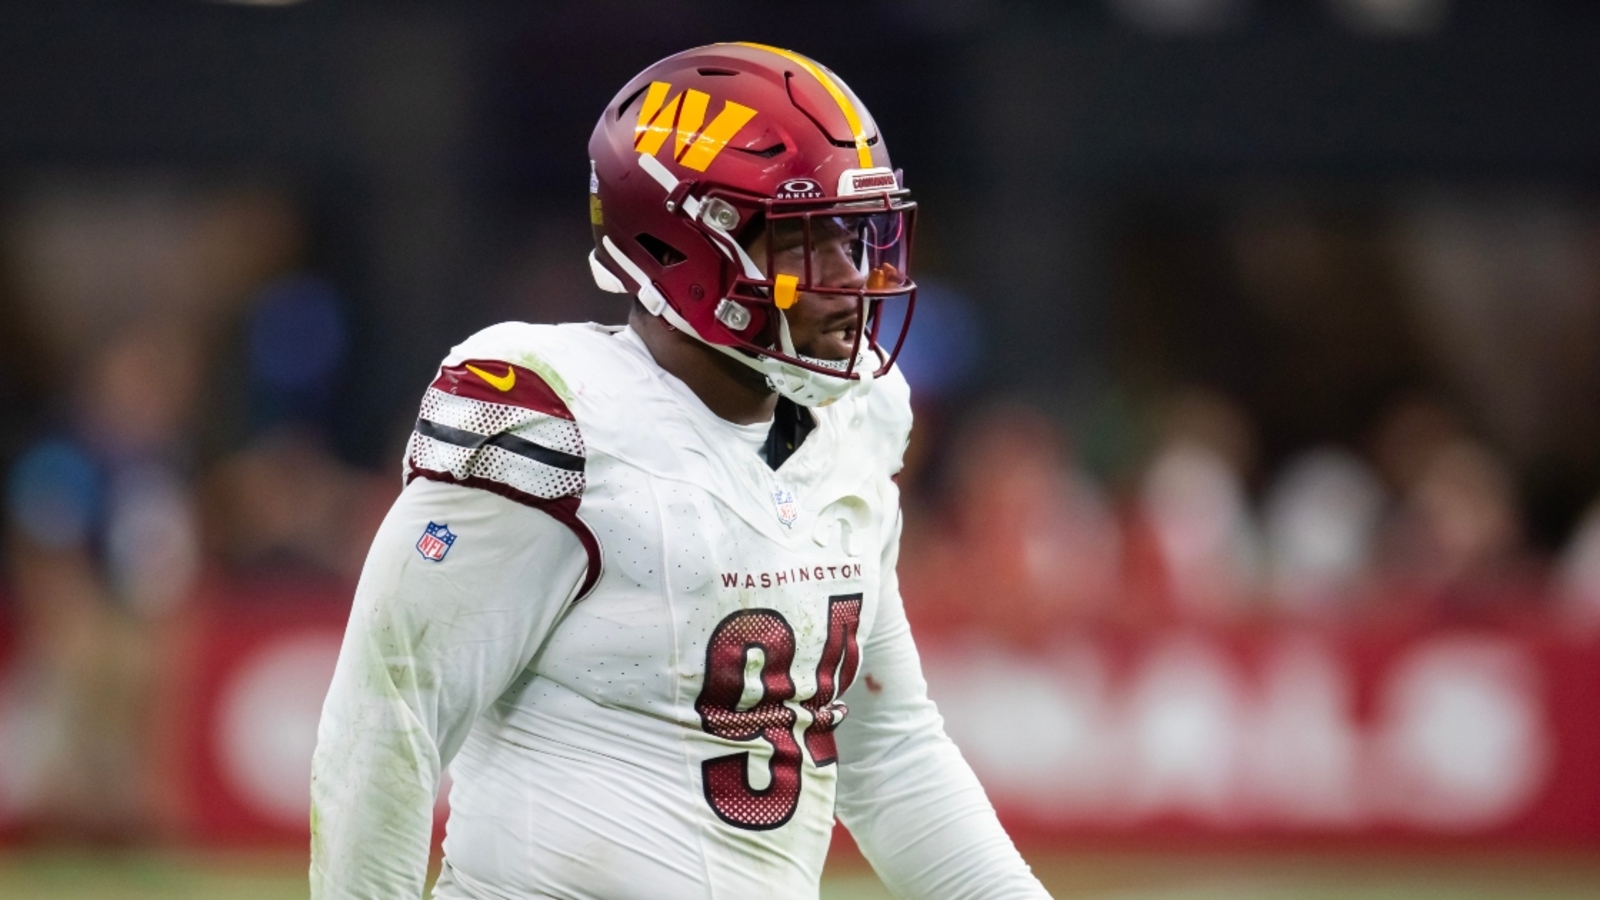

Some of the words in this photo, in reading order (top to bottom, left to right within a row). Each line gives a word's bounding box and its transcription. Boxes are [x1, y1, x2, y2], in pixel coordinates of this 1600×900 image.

[419, 534, 445, 558] NFL
[721, 563, 862, 589] WASHINGTON
[694, 592, 864, 831] 94
